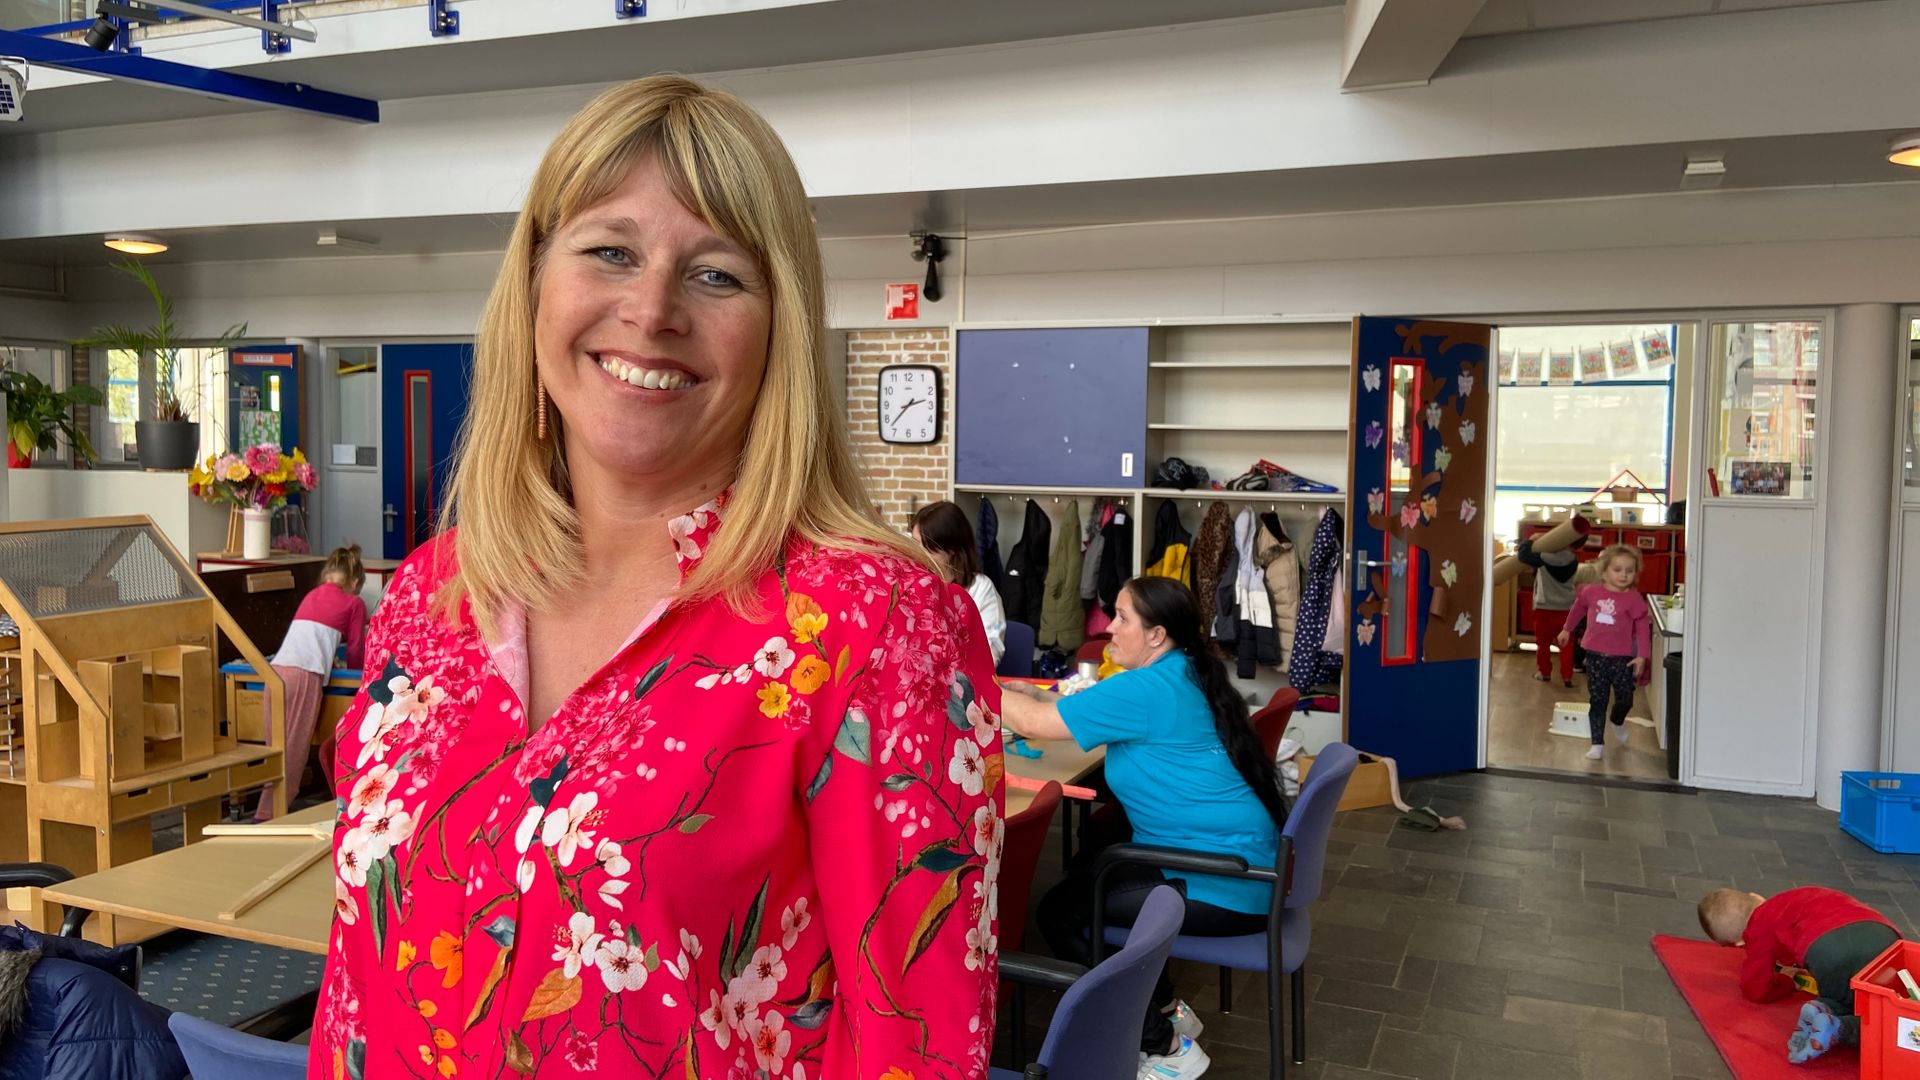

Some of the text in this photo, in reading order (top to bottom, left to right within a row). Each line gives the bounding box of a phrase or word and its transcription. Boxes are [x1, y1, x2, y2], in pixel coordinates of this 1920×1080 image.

[890, 373, 898, 382] 11
[904, 372, 913, 382] 12
[920, 373, 925, 382] 1
[884, 386, 893, 396] 10
[928, 386, 934, 396] 2
[884, 400, 890, 410] 9
[928, 400, 934, 410] 3
[884, 414, 890, 424] 8
[928, 415, 933, 424] 4
[891, 428, 897, 437] 7
[905, 428, 911, 438] 6
[920, 428, 926, 438] 5
